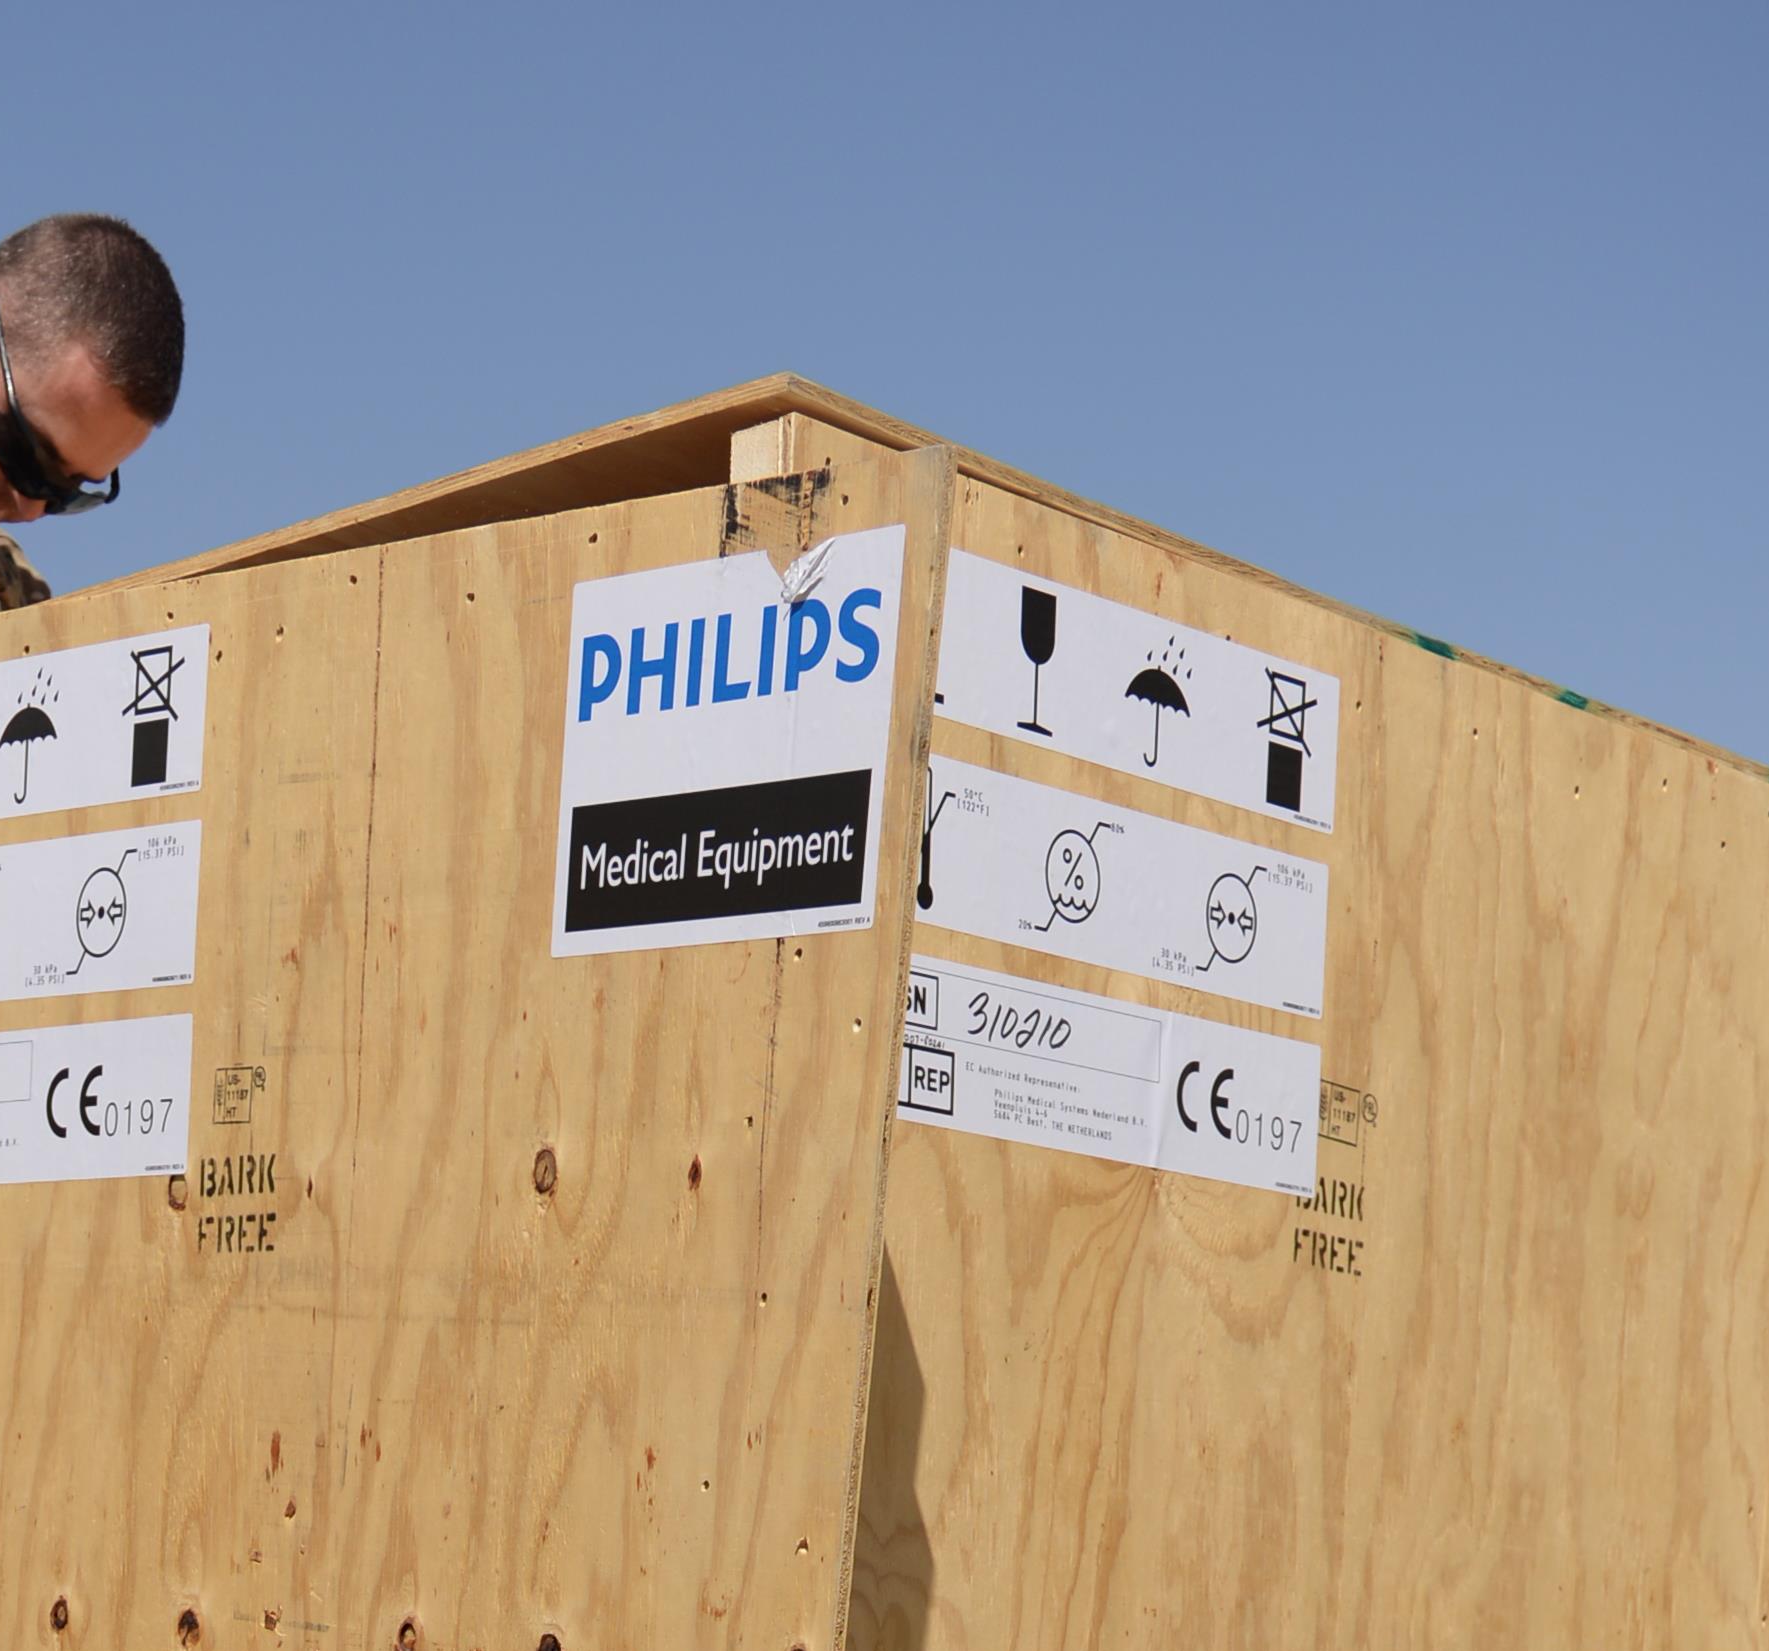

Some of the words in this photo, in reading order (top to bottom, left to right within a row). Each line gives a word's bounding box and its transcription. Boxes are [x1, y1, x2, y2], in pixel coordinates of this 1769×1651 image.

[578, 587, 882, 723] PHILIPS
[580, 833, 687, 890] Medical
[696, 823, 855, 890] Equipment
[968, 991, 1072, 1050] 310210
[46, 1065, 103, 1139] CE
[104, 1098, 173, 1138] 0197
[914, 1065, 950, 1094] REP
[1176, 1060, 1234, 1140] CE
[1235, 1109, 1302, 1153] 0197
[200, 1153, 276, 1197] BARK
[1296, 1176, 1365, 1221] ARK
[198, 1212, 276, 1255] FREE
[1293, 1228, 1364, 1277] FREE
